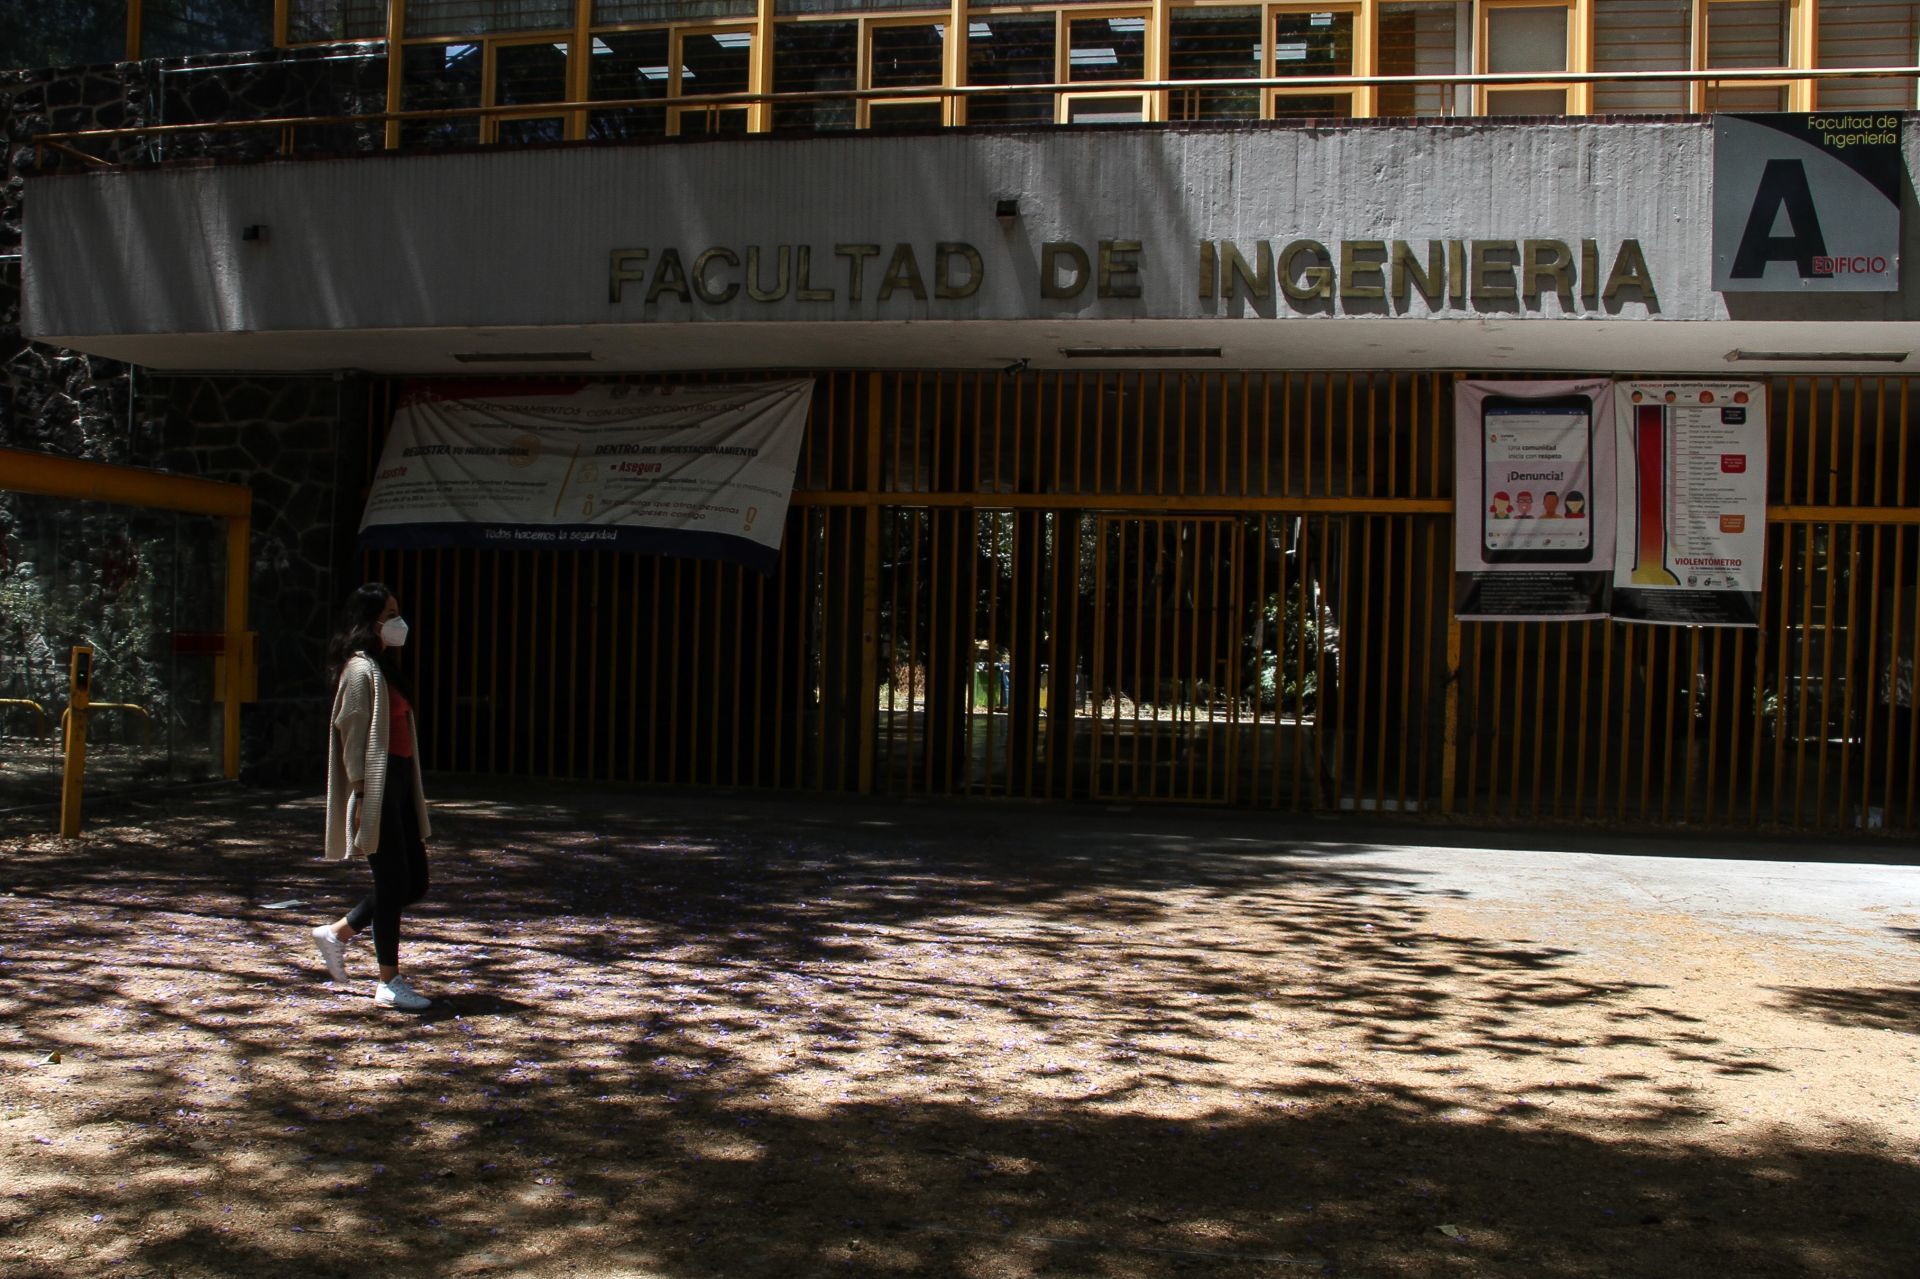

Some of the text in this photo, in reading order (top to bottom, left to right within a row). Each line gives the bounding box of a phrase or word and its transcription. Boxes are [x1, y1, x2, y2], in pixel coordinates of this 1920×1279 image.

[1808, 115, 1898, 130] Facultad de
[1824, 130, 1896, 148] Ingeniería
[1730, 159, 1834, 279] A
[609, 239, 1656, 303] FACULTAD DE INGENIERIA
[1812, 256, 1887, 274] EDIFICIO
[403, 445, 450, 458] REGISTRA
[465, 447, 496, 456] HUELLA
[595, 444, 640, 456] DENTRO
[642, 446, 656, 455] DEL
[1538, 453, 1562, 461] respeto
[618, 461, 662, 476] Asegura
[1507, 471, 1564, 483] ¡Denuncia!
[485, 528, 618, 542] Todos hacemos la seguridad
[1674, 557, 1742, 567] VIOLENTÓMETRO
